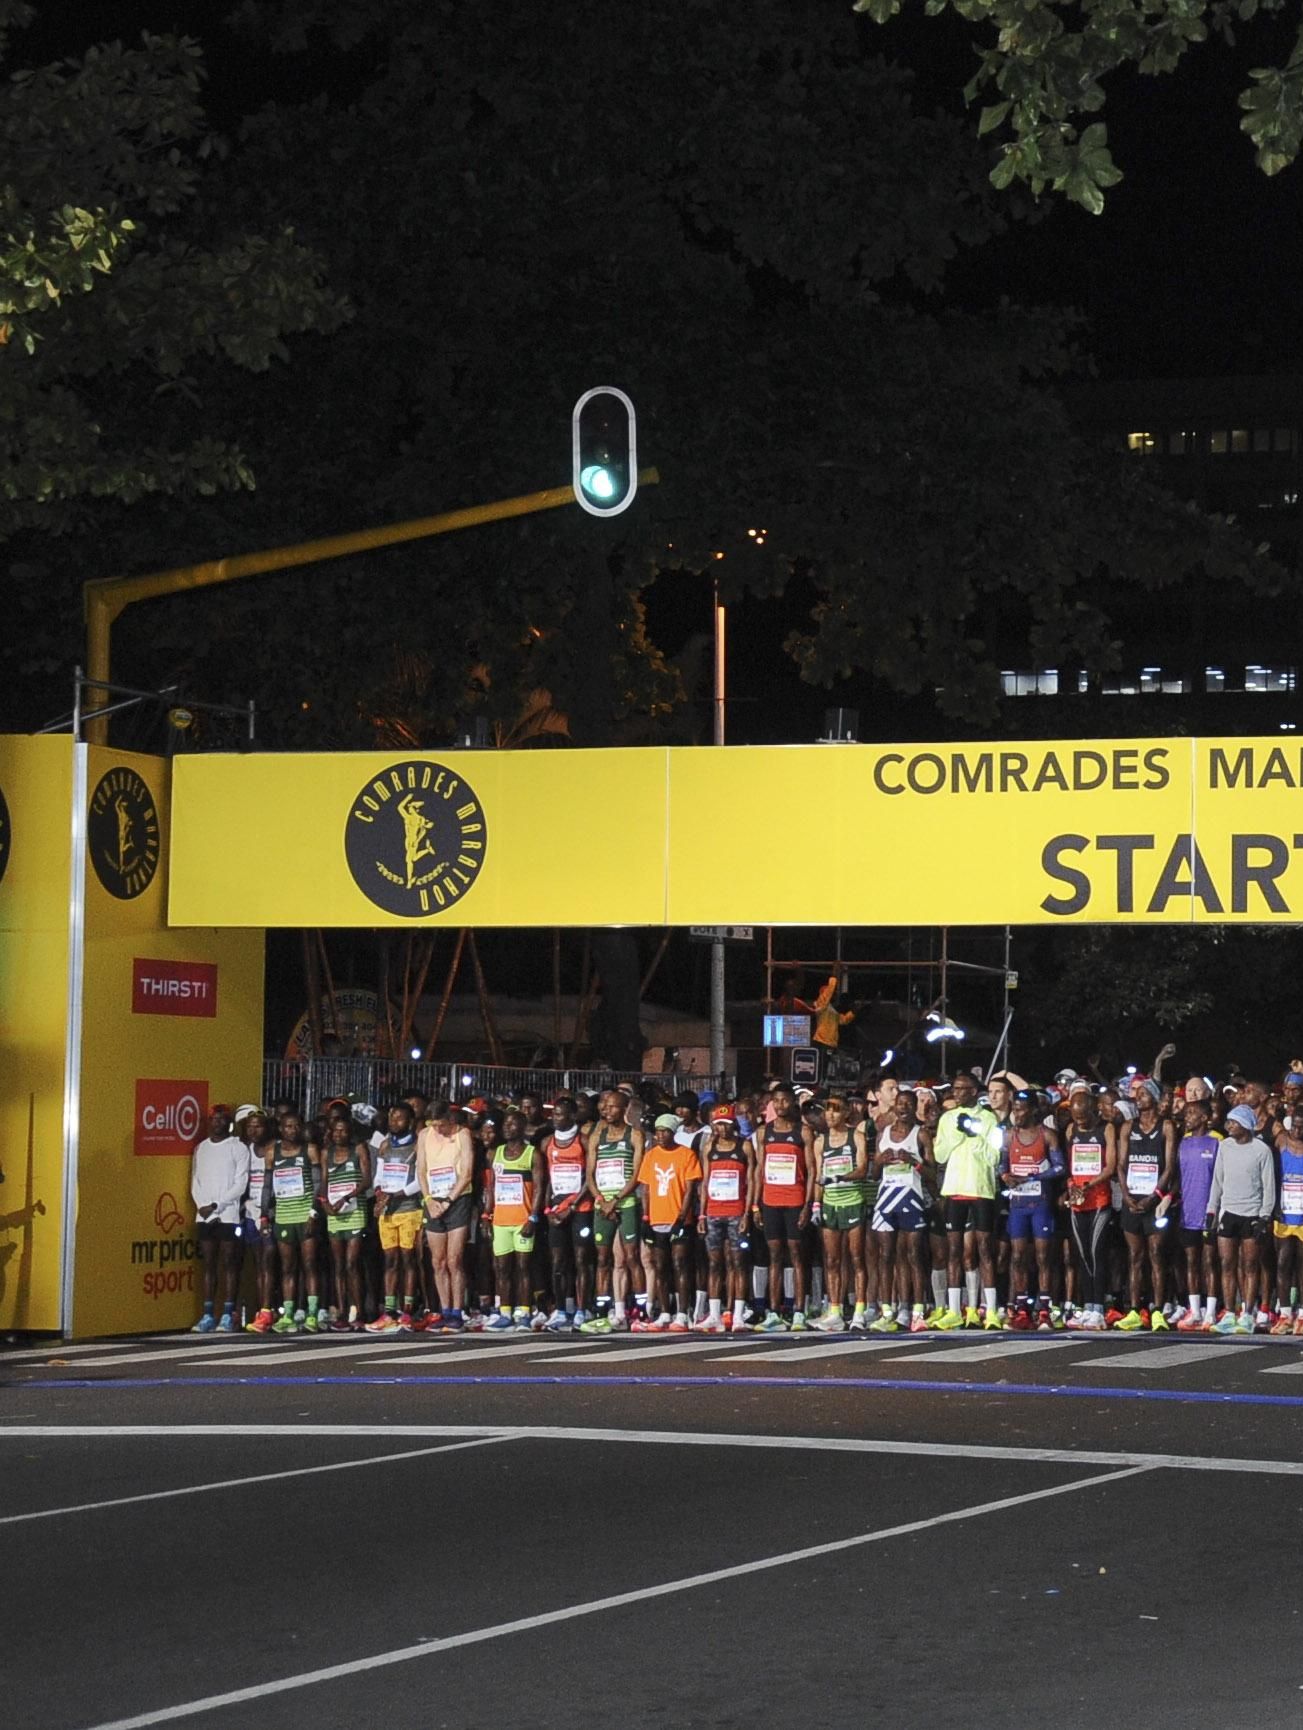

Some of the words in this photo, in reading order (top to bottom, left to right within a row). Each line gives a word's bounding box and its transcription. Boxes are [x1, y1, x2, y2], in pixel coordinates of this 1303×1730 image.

[873, 747, 1170, 795] COMRADES
[354, 766, 458, 823] COMRADES
[420, 802, 482, 911] MARATHON
[140, 977, 207, 999] THIRSTI
[142, 1104, 175, 1130] Cell
[142, 1265, 194, 1300] sport
